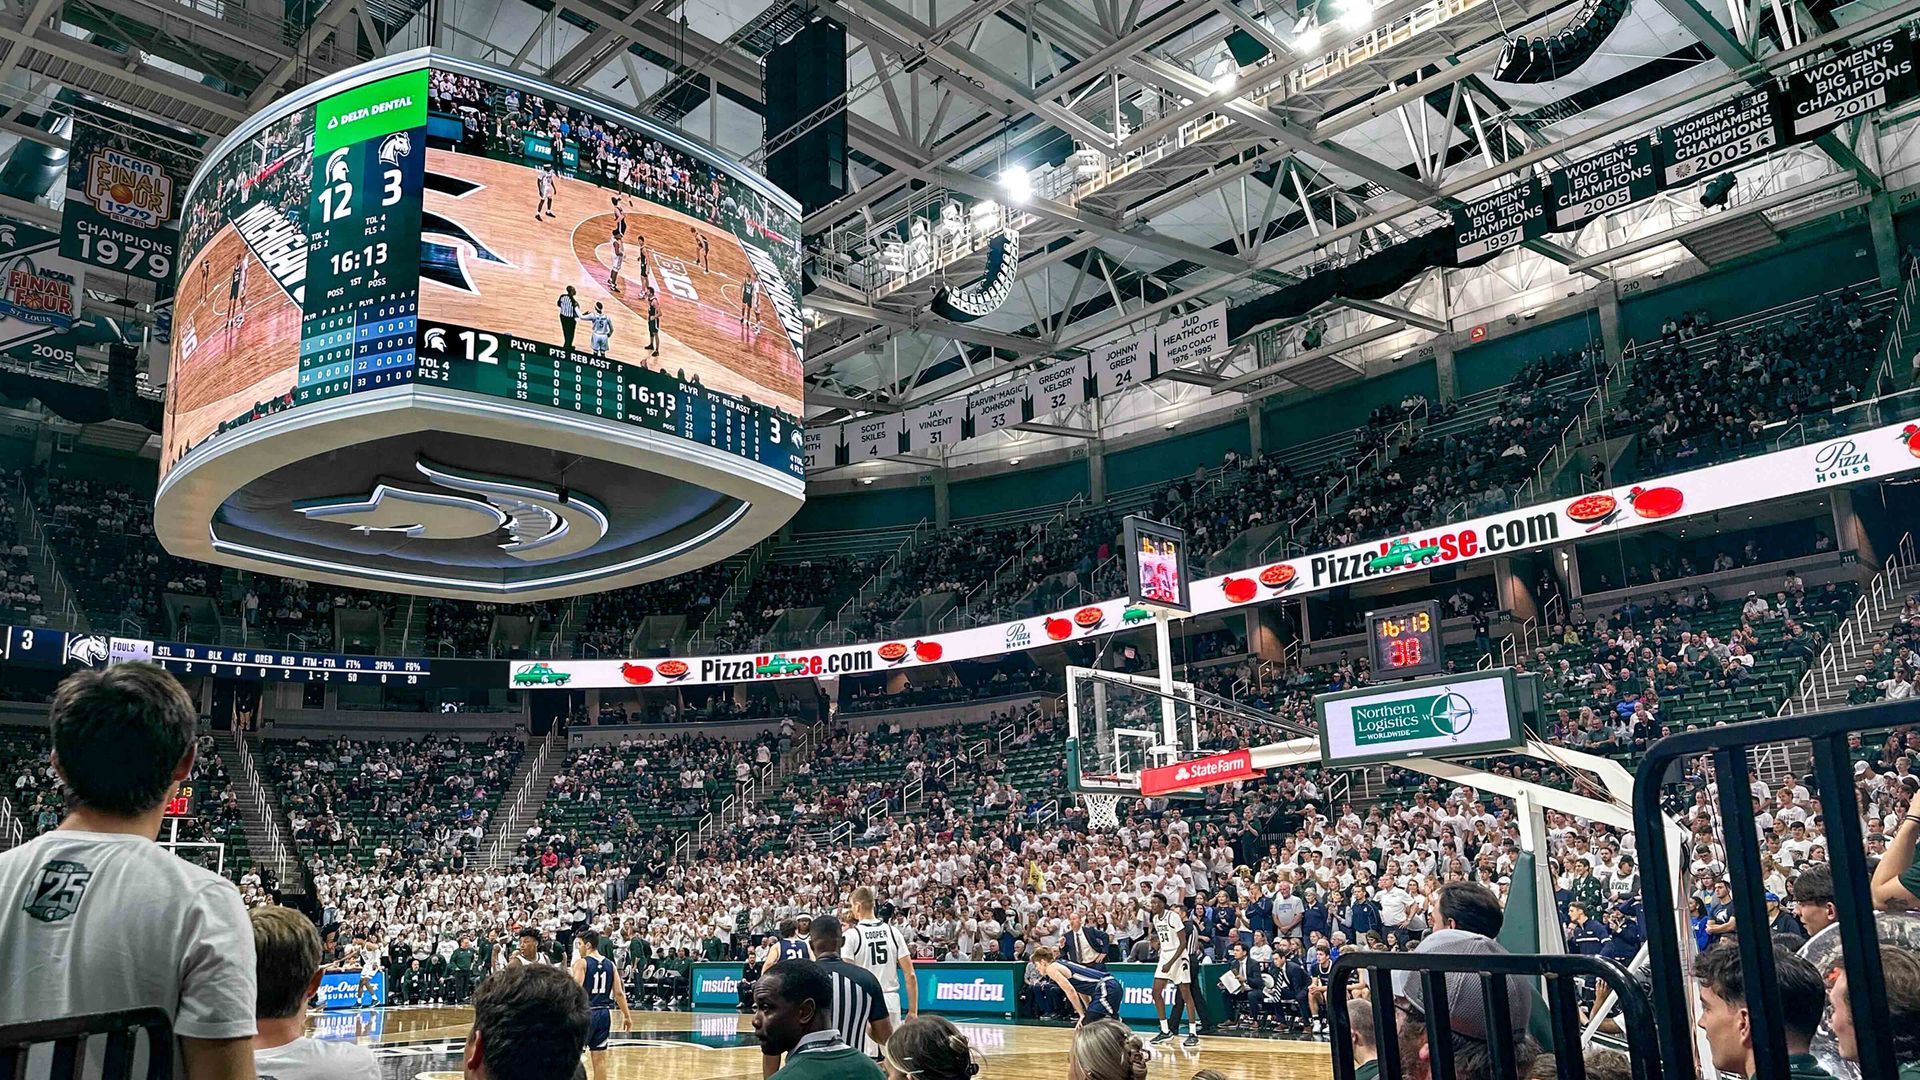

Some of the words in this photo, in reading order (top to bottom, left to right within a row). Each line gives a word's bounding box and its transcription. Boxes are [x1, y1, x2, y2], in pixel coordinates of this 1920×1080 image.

[1804, 38, 1895, 85] WOMEN'S
[1816, 74, 1846, 96] BIG
[1850, 57, 1888, 82] TEN
[1796, 60, 1912, 115] CHAMPIONS
[340, 108, 369, 125] DELTA
[371, 96, 412, 116] DENTAL
[1834, 93, 1878, 120] 2011
[1672, 105, 1736, 138] WOMEN'S
[1674, 102, 1769, 148] TOURNAMENT
[1675, 114, 1773, 161] CHAMPIONS
[108, 152, 154, 176] NCAA
[1564, 144, 1638, 180] WOMEN'S
[1694, 141, 1753, 173] 2005
[97, 160, 165, 198] FINAL
[1574, 168, 1599, 190] BIG
[1602, 158, 1632, 180] TEN
[382, 168, 402, 206] 3
[1558, 164, 1653, 208] CHAMPIONS
[318, 182, 353, 224] 12
[1464, 185, 1531, 218] WOMEN'S
[1583, 192, 1628, 216] 2005
[1900, 192, 1918, 204] 211
[105, 200, 152, 221] 1979
[1472, 210, 1496, 228] BIG
[1498, 200, 1525, 217] TEN
[364, 226, 377, 236] FLS
[365, 216, 378, 226] TOL
[1458, 204, 1544, 244] CHAMPIONS
[76, 220, 173, 256] CHAMPIONS
[311, 232, 323, 241] TOL
[1483, 230, 1518, 252] 1997
[78, 234, 170, 279] 1979
[310, 242, 322, 252] FLS
[330, 242, 388, 275] 16:13
[8, 268, 72, 299] FINAL
[38, 267, 74, 284] NCAA
[350, 276, 362, 286] 1ST
[368, 277, 386, 288] POSS
[327, 287, 344, 298] POSS
[1623, 280, 1640, 293] 210
[24, 314, 52, 322] LOUIS
[1180, 315, 1200, 329] JUD
[1163, 318, 1220, 348] HEATHCOTE
[32, 344, 74, 362] 2005
[458, 330, 499, 365] 12
[510, 339, 536, 352] PLYR
[550, 348, 566, 359] PTS
[570, 352, 588, 364] REB
[590, 358, 611, 370] ASST
[1105, 342, 1139, 362] JOHNNY
[1167, 344, 1187, 358] HEAD
[1188, 333, 1217, 350] COACH
[1172, 352, 1188, 365] 1976
[1194, 345, 1212, 358] 1995
[1418, 346, 1434, 358] 209
[419, 356, 440, 369] TOL
[442, 360, 450, 370] 4
[1109, 354, 1138, 371] GREEN
[418, 367, 438, 379] FLS
[441, 371, 449, 381] 2
[1038, 365, 1076, 386] GREGORY
[1115, 369, 1133, 387] 24
[1044, 378, 1073, 394] KELSER
[628, 383, 676, 411] 16:13
[679, 383, 699, 396] PLYR
[707, 393, 720, 404] PTS
[722, 398, 735, 408] REB
[736, 403, 750, 415] ASST
[970, 394, 997, 409] EARVIN
[981, 397, 1016, 416] JOHNSON
[1051, 393, 1067, 410] 32
[628, 413, 642, 422] POSS
[646, 407, 659, 417] 1ST
[927, 409, 943, 419] JAY
[991, 413, 1006, 428] 33
[1233, 407, 1248, 416] 208
[662, 423, 675, 432] POSS
[770, 417, 781, 444] 3
[860, 422, 886, 434] SCOTT
[919, 416, 953, 430] VINCENT
[861, 431, 886, 443] SKILES
[930, 431, 942, 444] 31
[804, 455, 815, 466] 21
[869, 445, 878, 456] 4
[1382, 612, 1430, 638] 16:13
[21, 630, 34, 650] 3
[112, 642, 135, 652] FOULS
[143, 645, 148, 654] 4
[158, 646, 172, 656] STL
[186, 649, 195, 658] TO
[208, 651, 222, 660] BLK
[232, 652, 247, 662] AST
[255, 654, 273, 665] OREB
[281, 656, 295, 666] REB
[345, 660, 361, 670] FT%
[375, 661, 394, 671] 3FG%
[405, 662, 420, 671] FG%
[1390, 637, 1421, 668] 30
[348, 672, 357, 682] 50
[408, 675, 417, 684] 20
[1356, 703, 1416, 720] Northern
[1358, 715, 1419, 732] Logistics
[1367, 730, 1411, 740] WORLDWIDE
[24, 868, 92, 914] 125
[865, 931, 888, 939] COOPER
[1160, 933, 1168, 942] 34
[868, 941, 888, 965] 15
[593, 972, 607, 994] 11
[936, 978, 1005, 1002] msufcu
